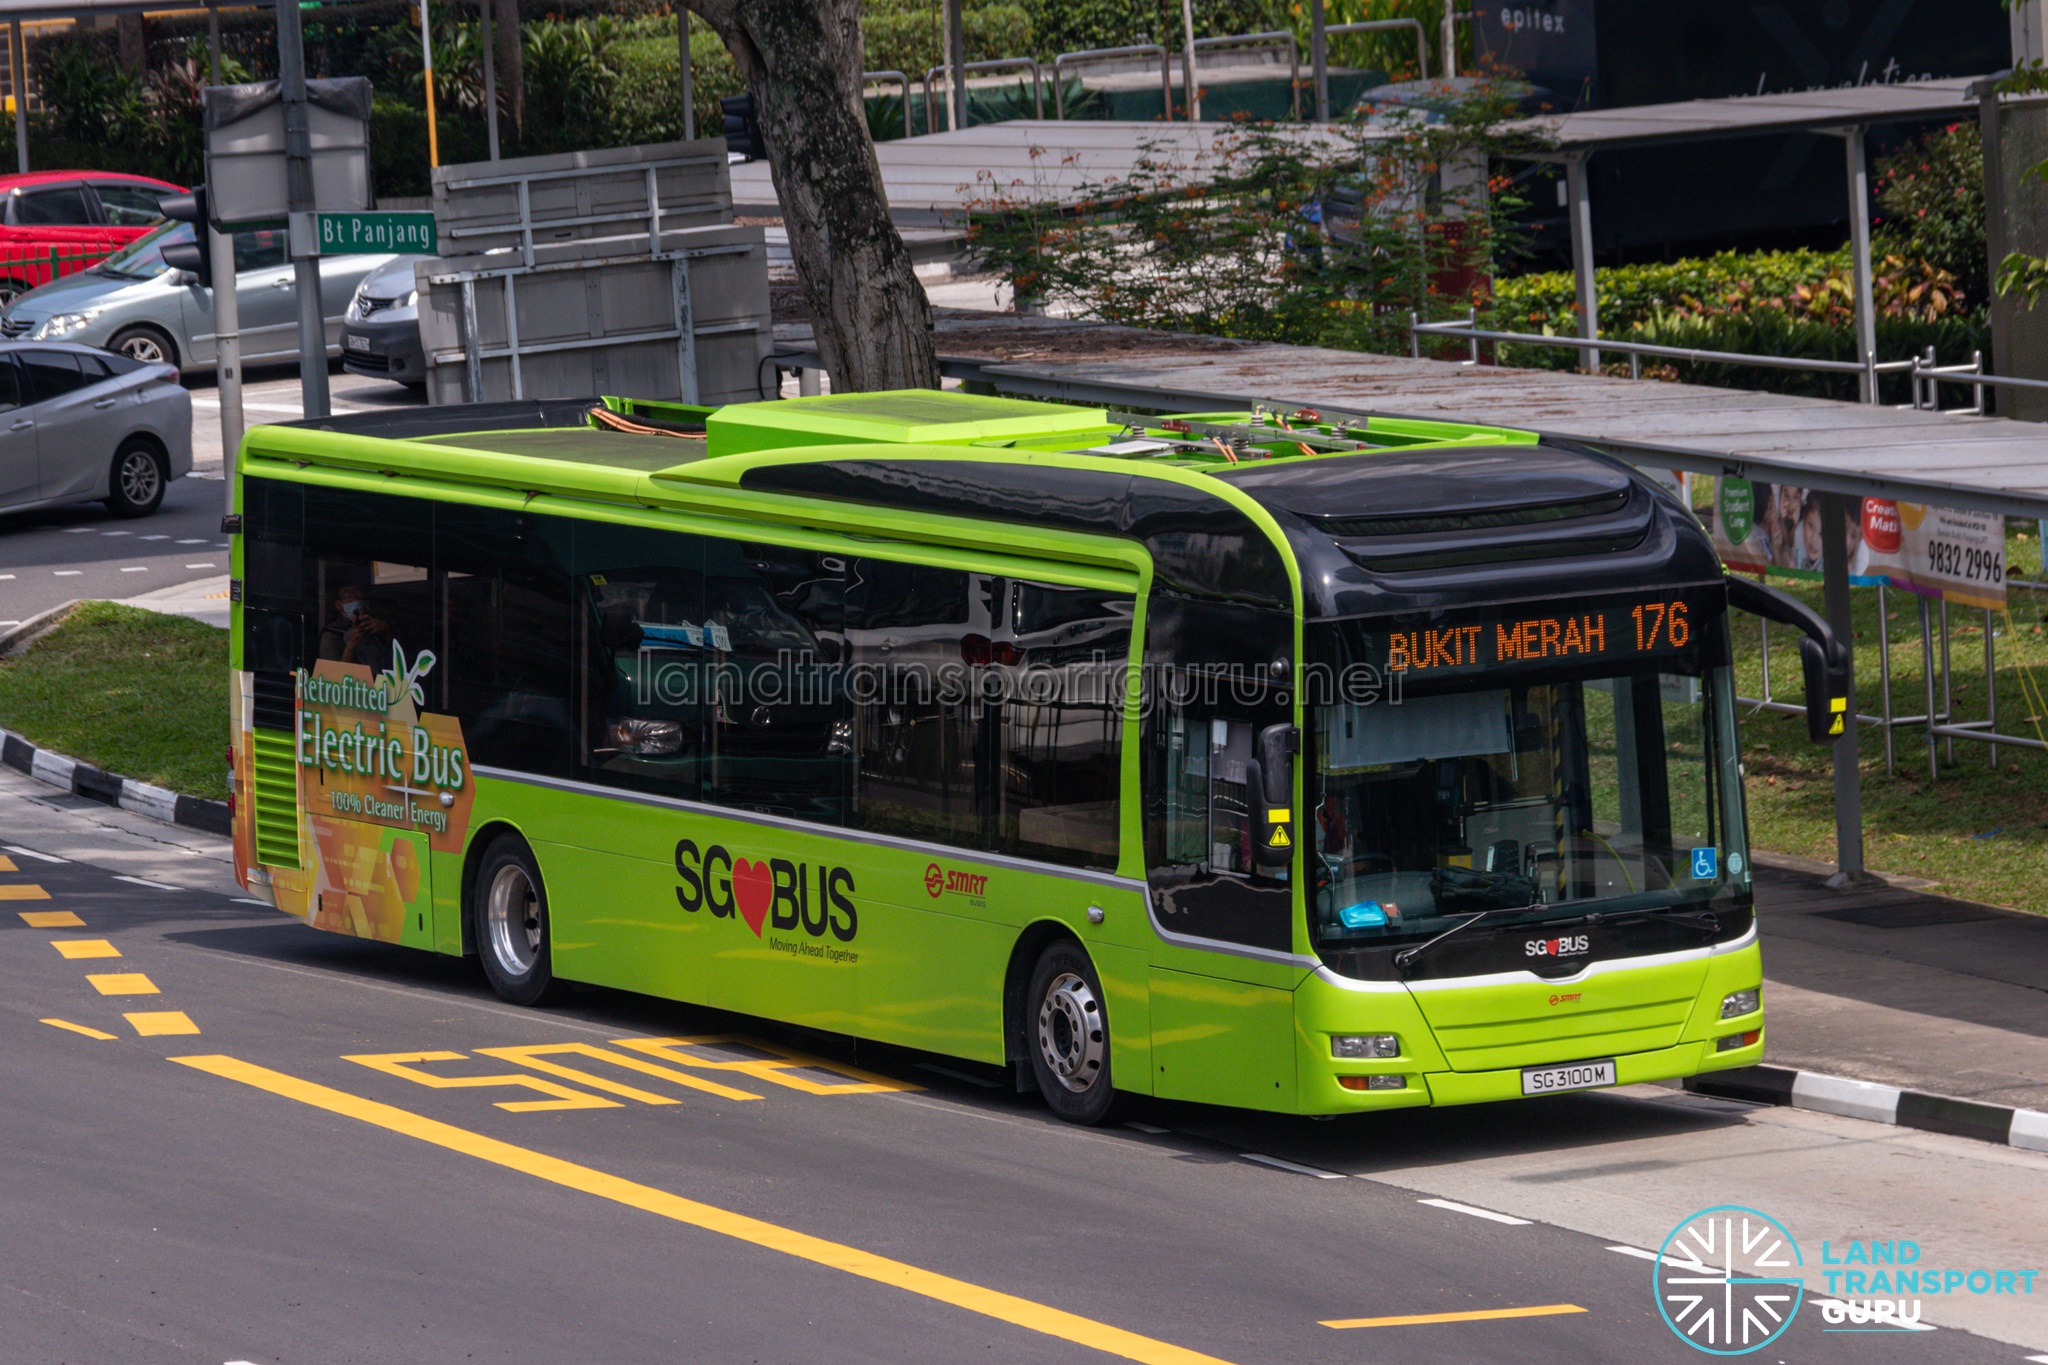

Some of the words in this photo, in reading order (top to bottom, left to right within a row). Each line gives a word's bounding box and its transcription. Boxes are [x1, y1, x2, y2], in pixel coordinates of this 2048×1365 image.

[323, 218, 344, 243] Bt
[351, 218, 429, 249] Panjang
[1724, 498, 1750, 512] Student
[1928, 540, 1961, 576] 9832
[1965, 547, 2002, 583] 2996
[1390, 626, 1482, 672] BUKIT
[1496, 613, 1605, 661] MERAH
[1632, 601, 1690, 651] 176
[297, 667, 388, 713] Retrofitted
[297, 710, 402, 779] Electric
[412, 726, 464, 789] Bus
[330, 790, 362, 814] 100%
[364, 794, 405, 820] Cleaner
[410, 802, 447, 832] Energy
[945, 870, 989, 896] SMRT
[769, 936, 798, 957] Moving
[799, 941, 824, 958] Ahead
[825, 945, 859, 964] Together
